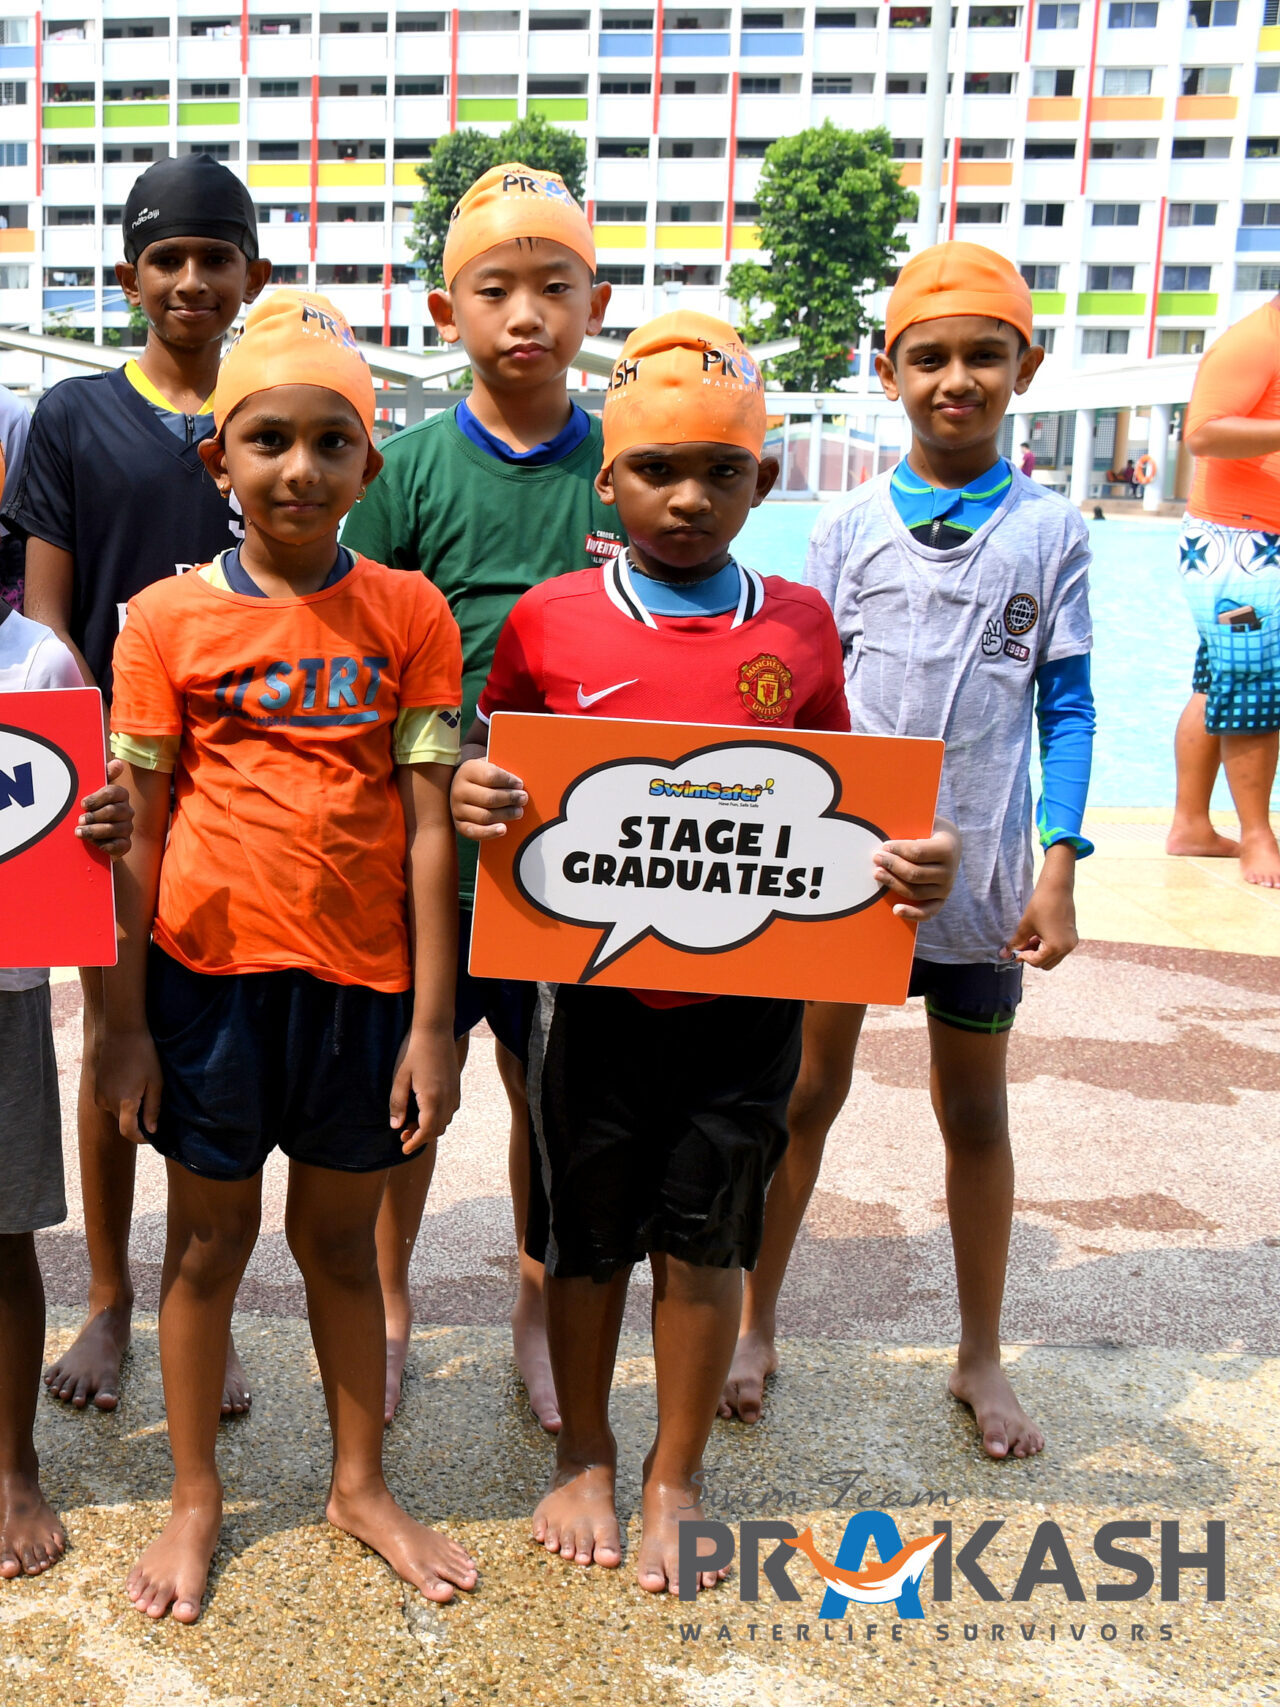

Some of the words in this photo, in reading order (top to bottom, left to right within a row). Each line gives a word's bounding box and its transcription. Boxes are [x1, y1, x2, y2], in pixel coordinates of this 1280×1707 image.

[746, 659, 788, 684] MANCHESTER
[752, 702, 782, 715] UNITED
[649, 778, 763, 802] SwimSafer
[618, 816, 763, 856] STAGE
[775, 825, 792, 859] I
[562, 851, 824, 900] GRADUATES!
